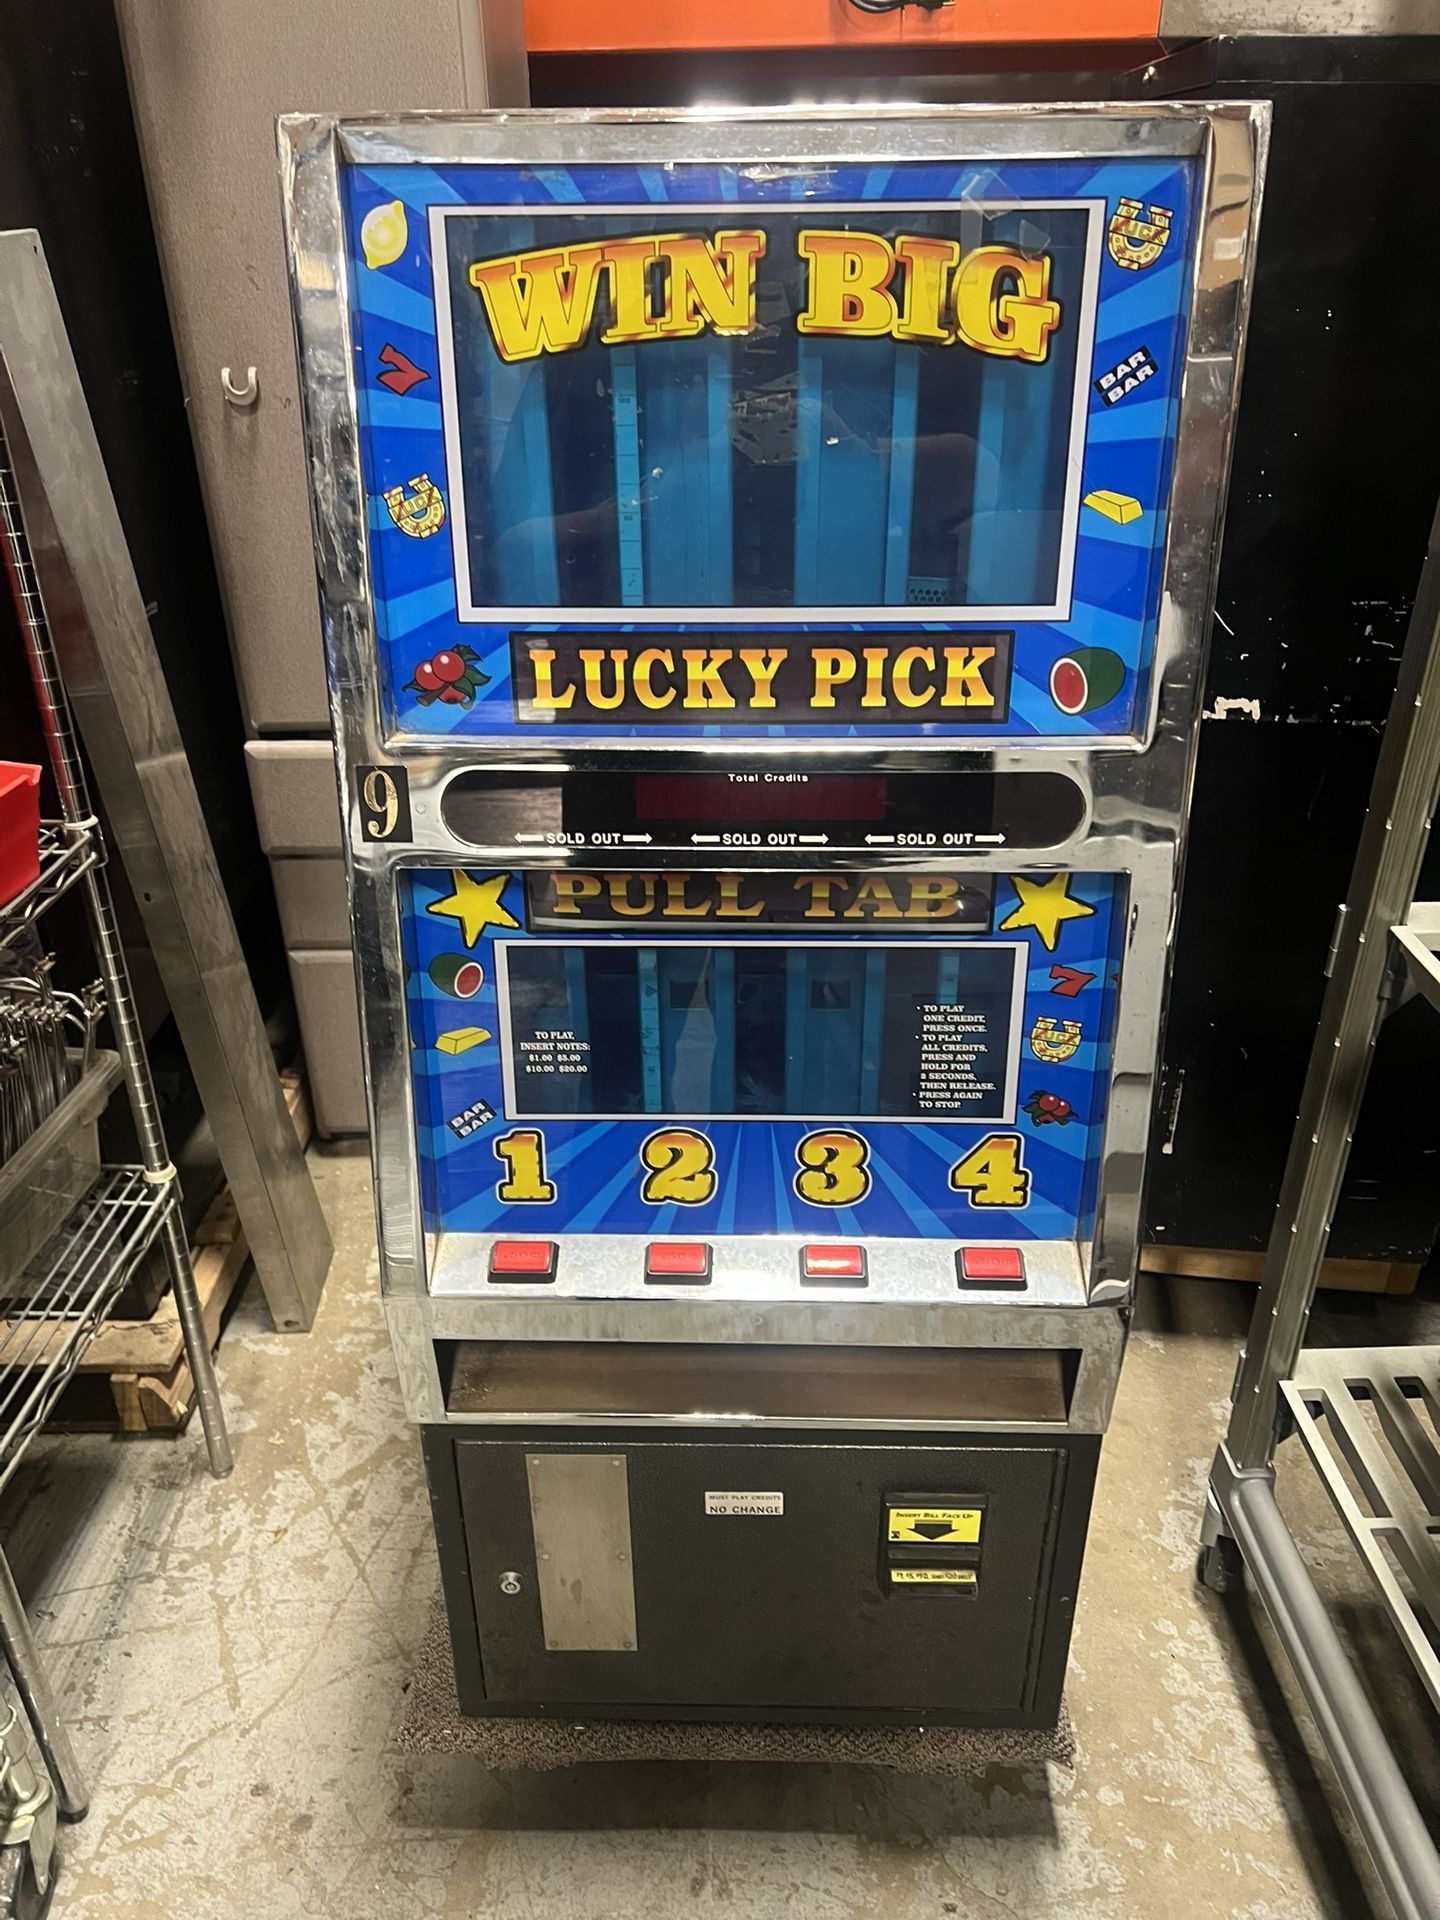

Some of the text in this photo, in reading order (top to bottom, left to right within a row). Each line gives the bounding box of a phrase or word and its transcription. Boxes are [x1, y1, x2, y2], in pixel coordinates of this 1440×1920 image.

[470, 230, 1060, 362] WIN BIG
[1100, 351, 1146, 390] BAR
[1108, 365, 1154, 403] BAR
[529, 646, 996, 709] LUCKY PICK
[728, 774, 809, 782] Total Credits
[364, 769, 398, 837] 9
[546, 833, 621, 845] SOLD OUT
[722, 833, 797, 845] SOLD OUT
[897, 833, 973, 845] SOLD OUT
[550, 874, 961, 918] PULL TAB
[535, 1031, 575, 1040] TO PLAY,
[520, 1042, 591, 1051] INSERT NOTES:
[528, 1054, 553, 1062] $1.00
[525, 1065, 588, 1073] $10.00 $20.00
[949, 1082, 996, 1090] RELEASE.
[919, 1091, 951, 1099] PRESS
[451, 1102, 486, 1128] BAR
[459, 1111, 494, 1137] BAR
[496, 1129, 1029, 1206] 1 2 3 4
[732, 1506, 781, 1514] CHANGE
